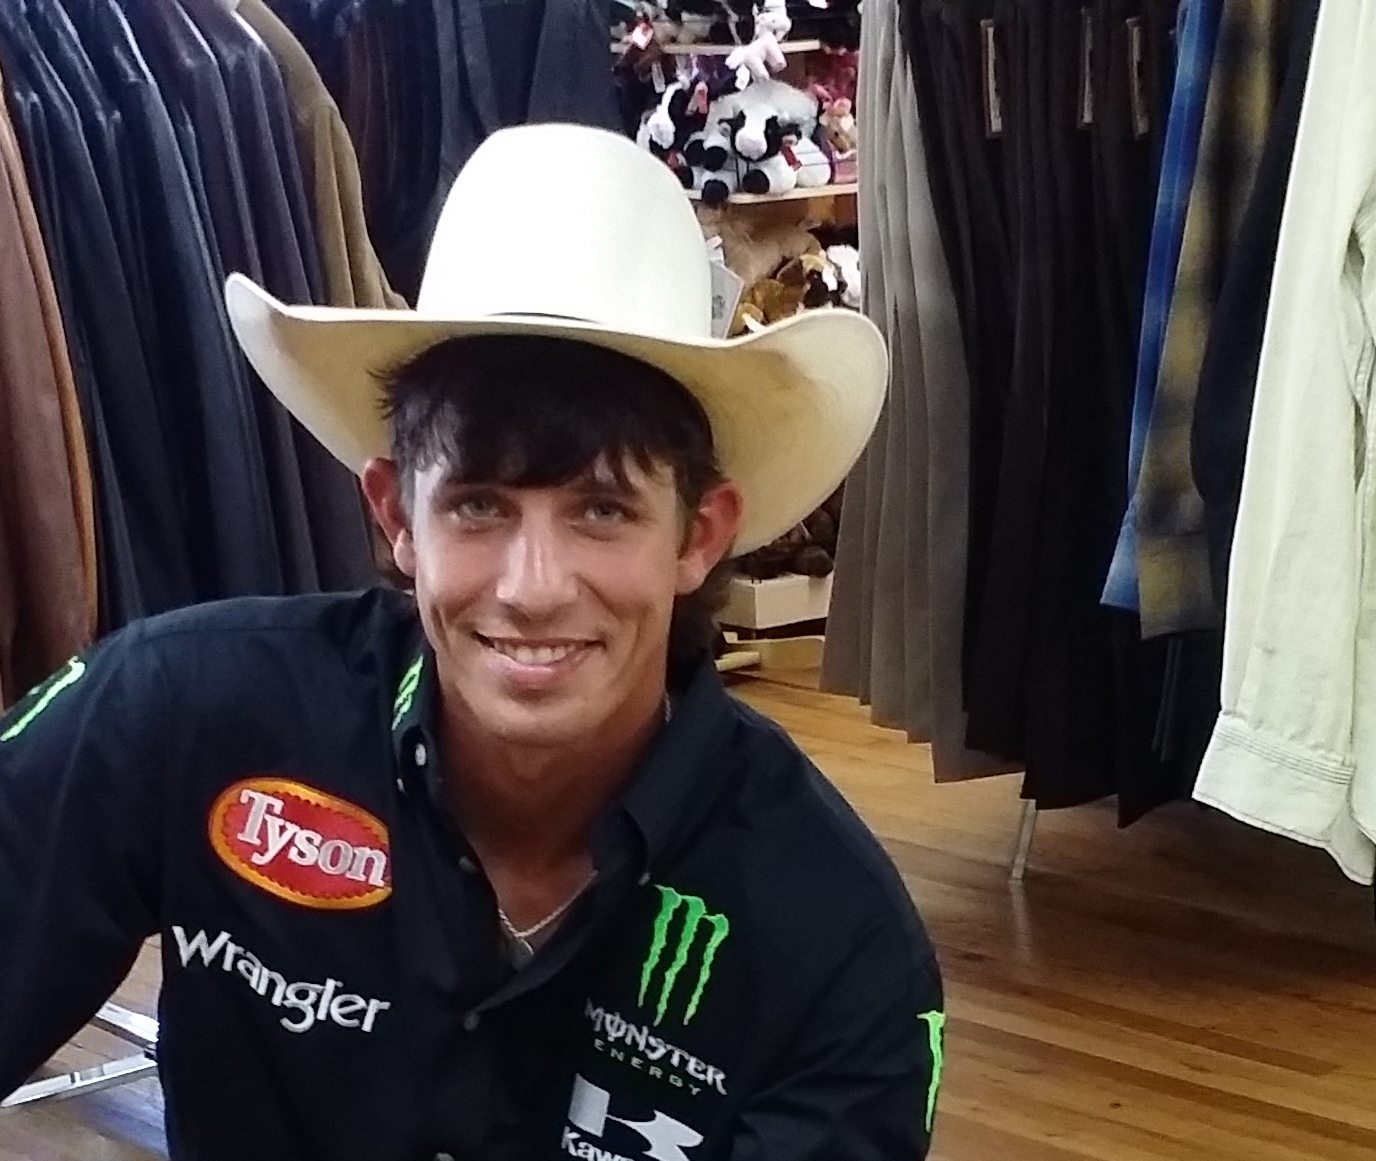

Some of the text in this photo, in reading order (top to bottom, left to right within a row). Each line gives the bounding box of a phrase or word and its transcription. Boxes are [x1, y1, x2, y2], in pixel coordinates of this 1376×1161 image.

[235, 788, 389, 887] Tyson
[172, 925, 391, 1033] Wrangler
[584, 998, 728, 1096] MONSTER
[594, 1038, 702, 1096] ENERGY
